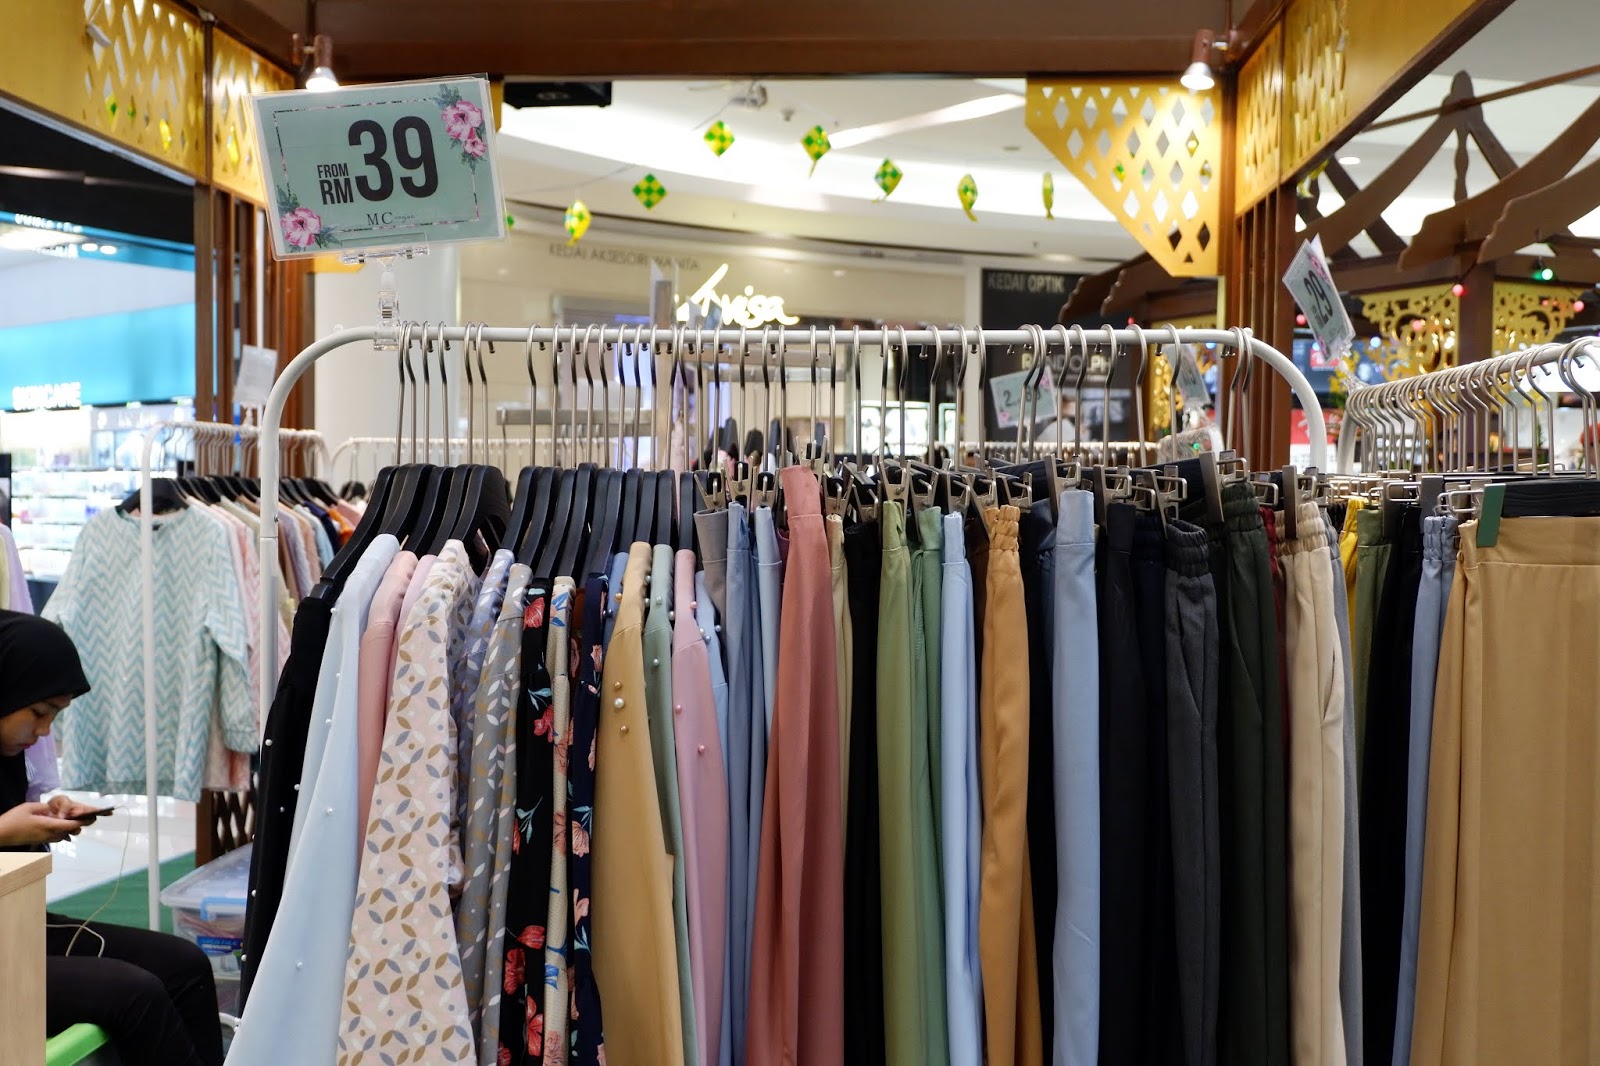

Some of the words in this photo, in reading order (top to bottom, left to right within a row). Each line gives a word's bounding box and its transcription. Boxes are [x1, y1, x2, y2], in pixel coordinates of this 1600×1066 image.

[319, 178, 354, 205] RM
[348, 116, 438, 202] 39
[317, 163, 349, 178] FROM
[366, 211, 393, 225] MC
[549, 243, 586, 259] KEDAI
[988, 271, 1025, 291] KEDAI
[1027, 274, 1064, 294] OPTIK
[1303, 270, 1333, 326] 29
